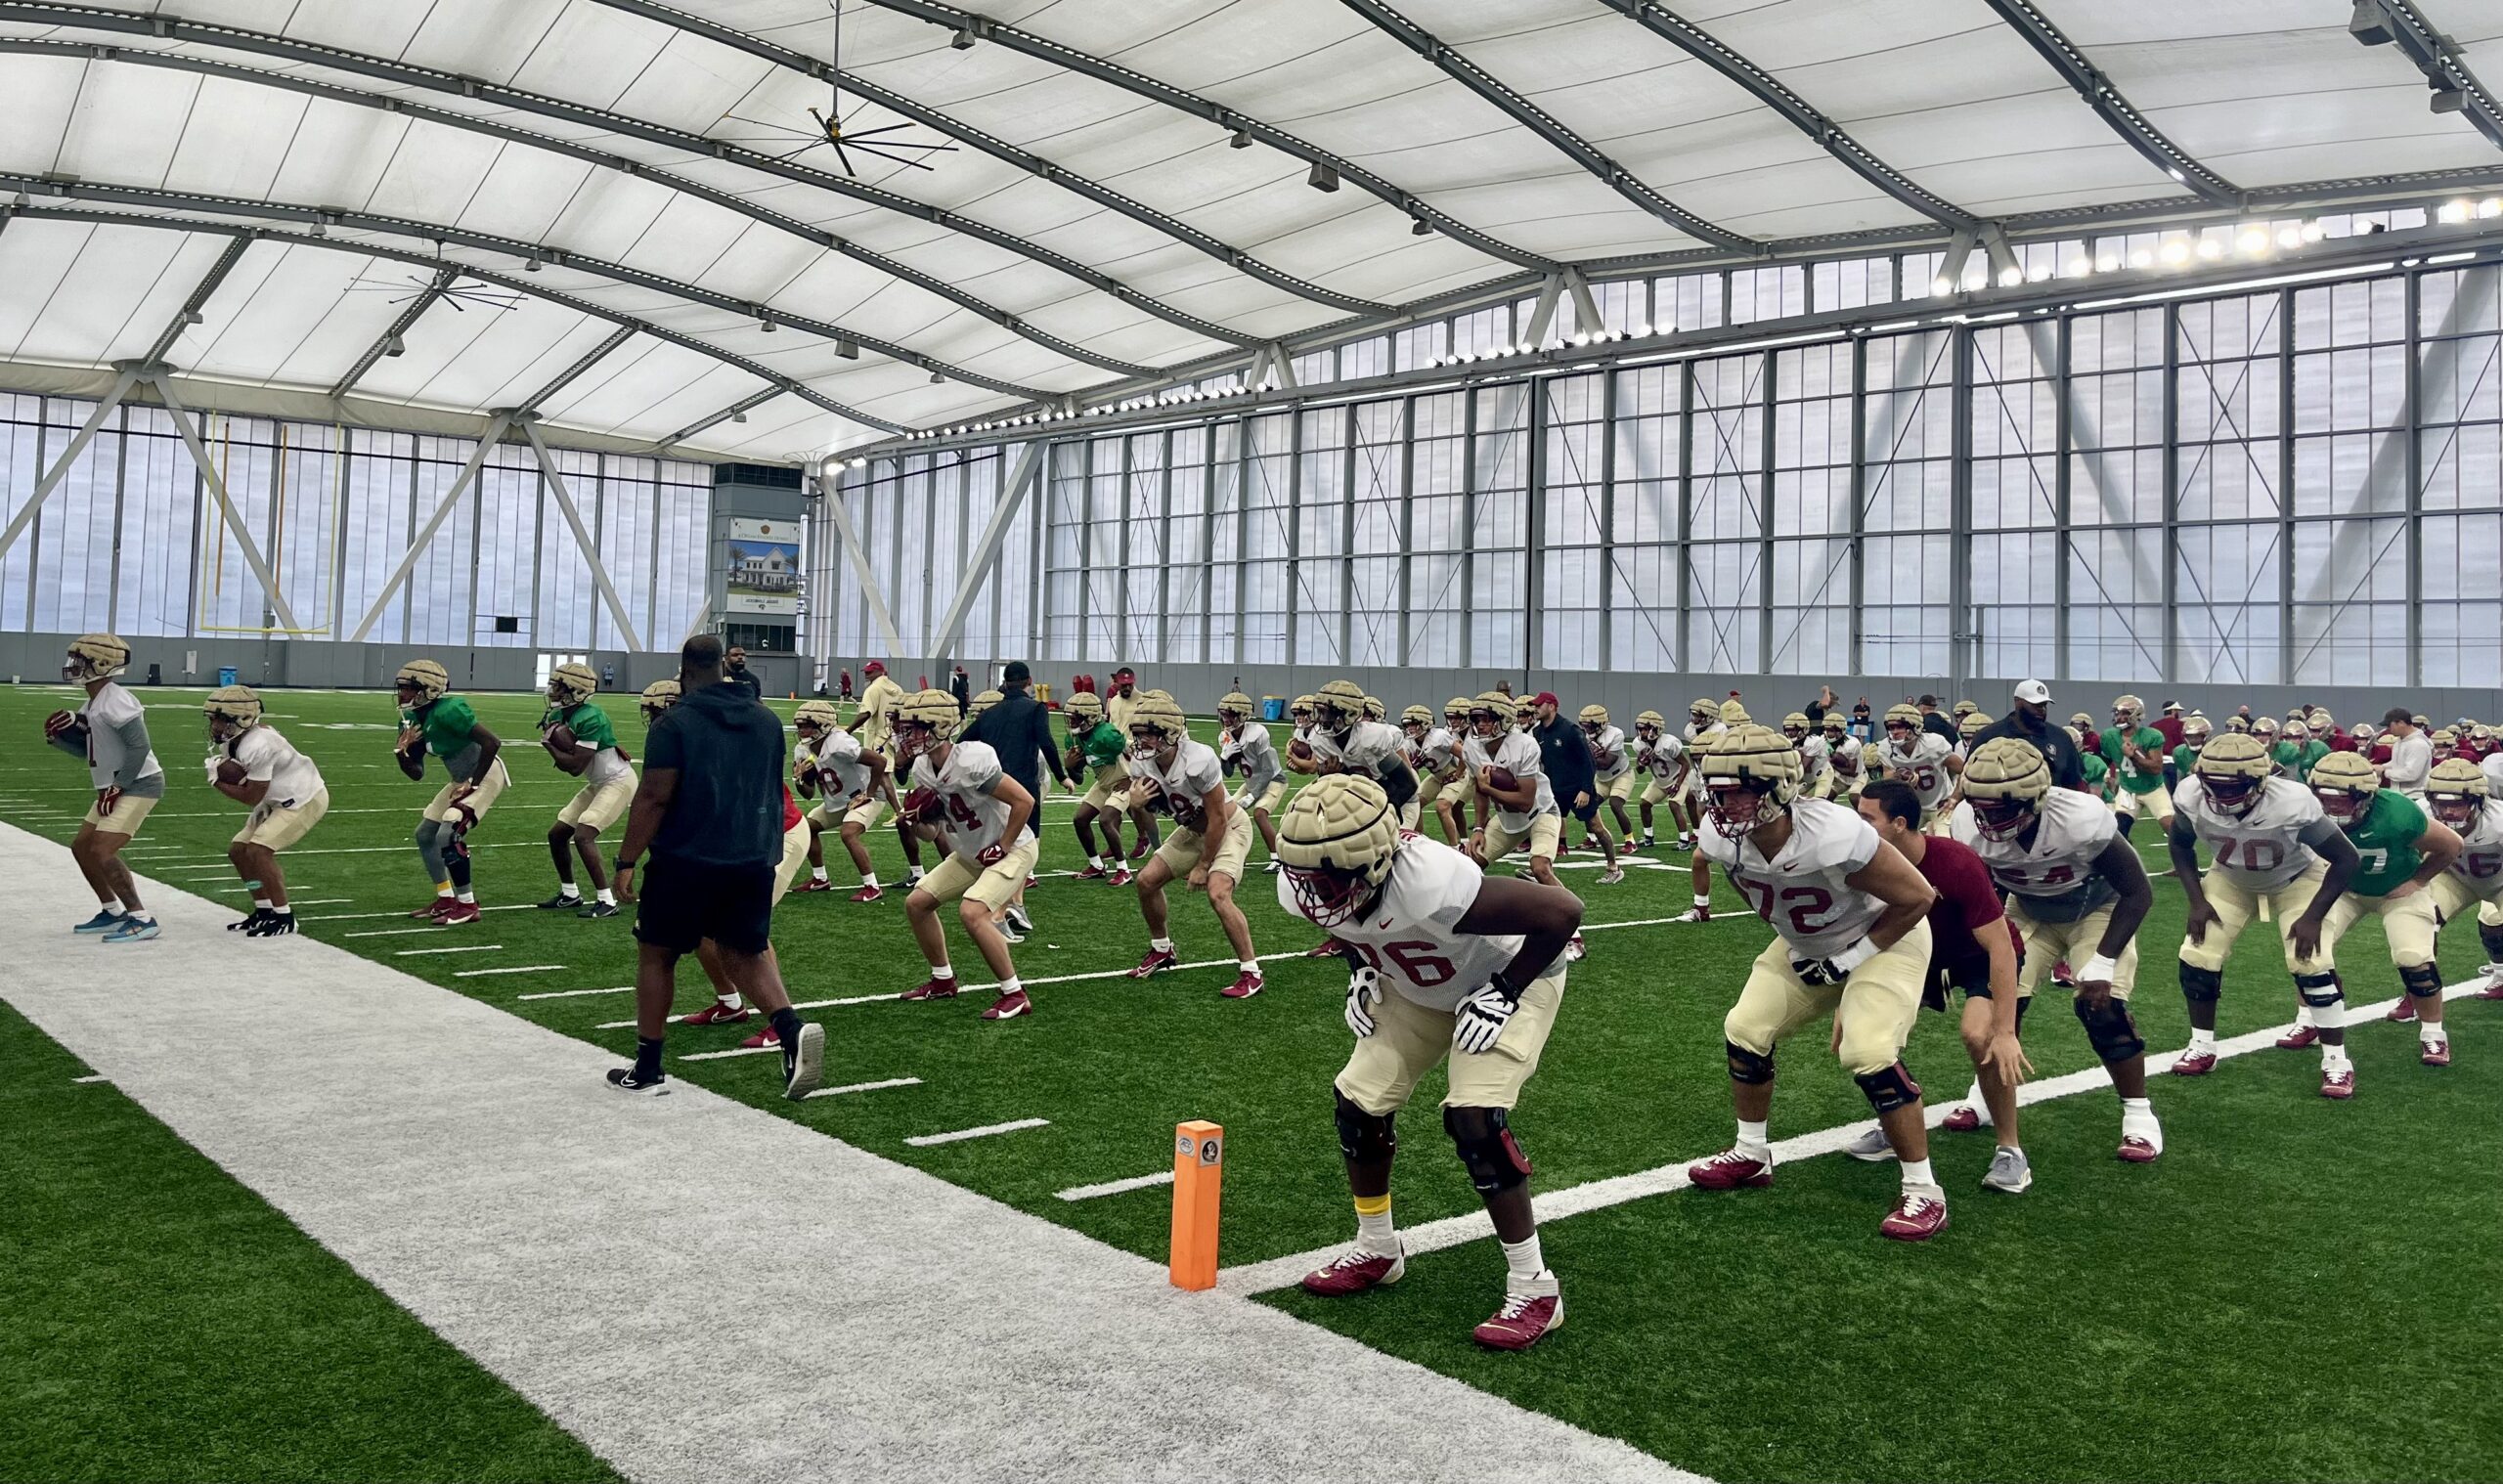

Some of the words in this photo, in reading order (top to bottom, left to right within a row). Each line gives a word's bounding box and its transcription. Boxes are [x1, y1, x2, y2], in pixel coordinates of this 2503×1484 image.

[2120, 756, 2137, 778] 4
[2205, 833, 2285, 871] 70
[1736, 877, 1837, 935] 72
